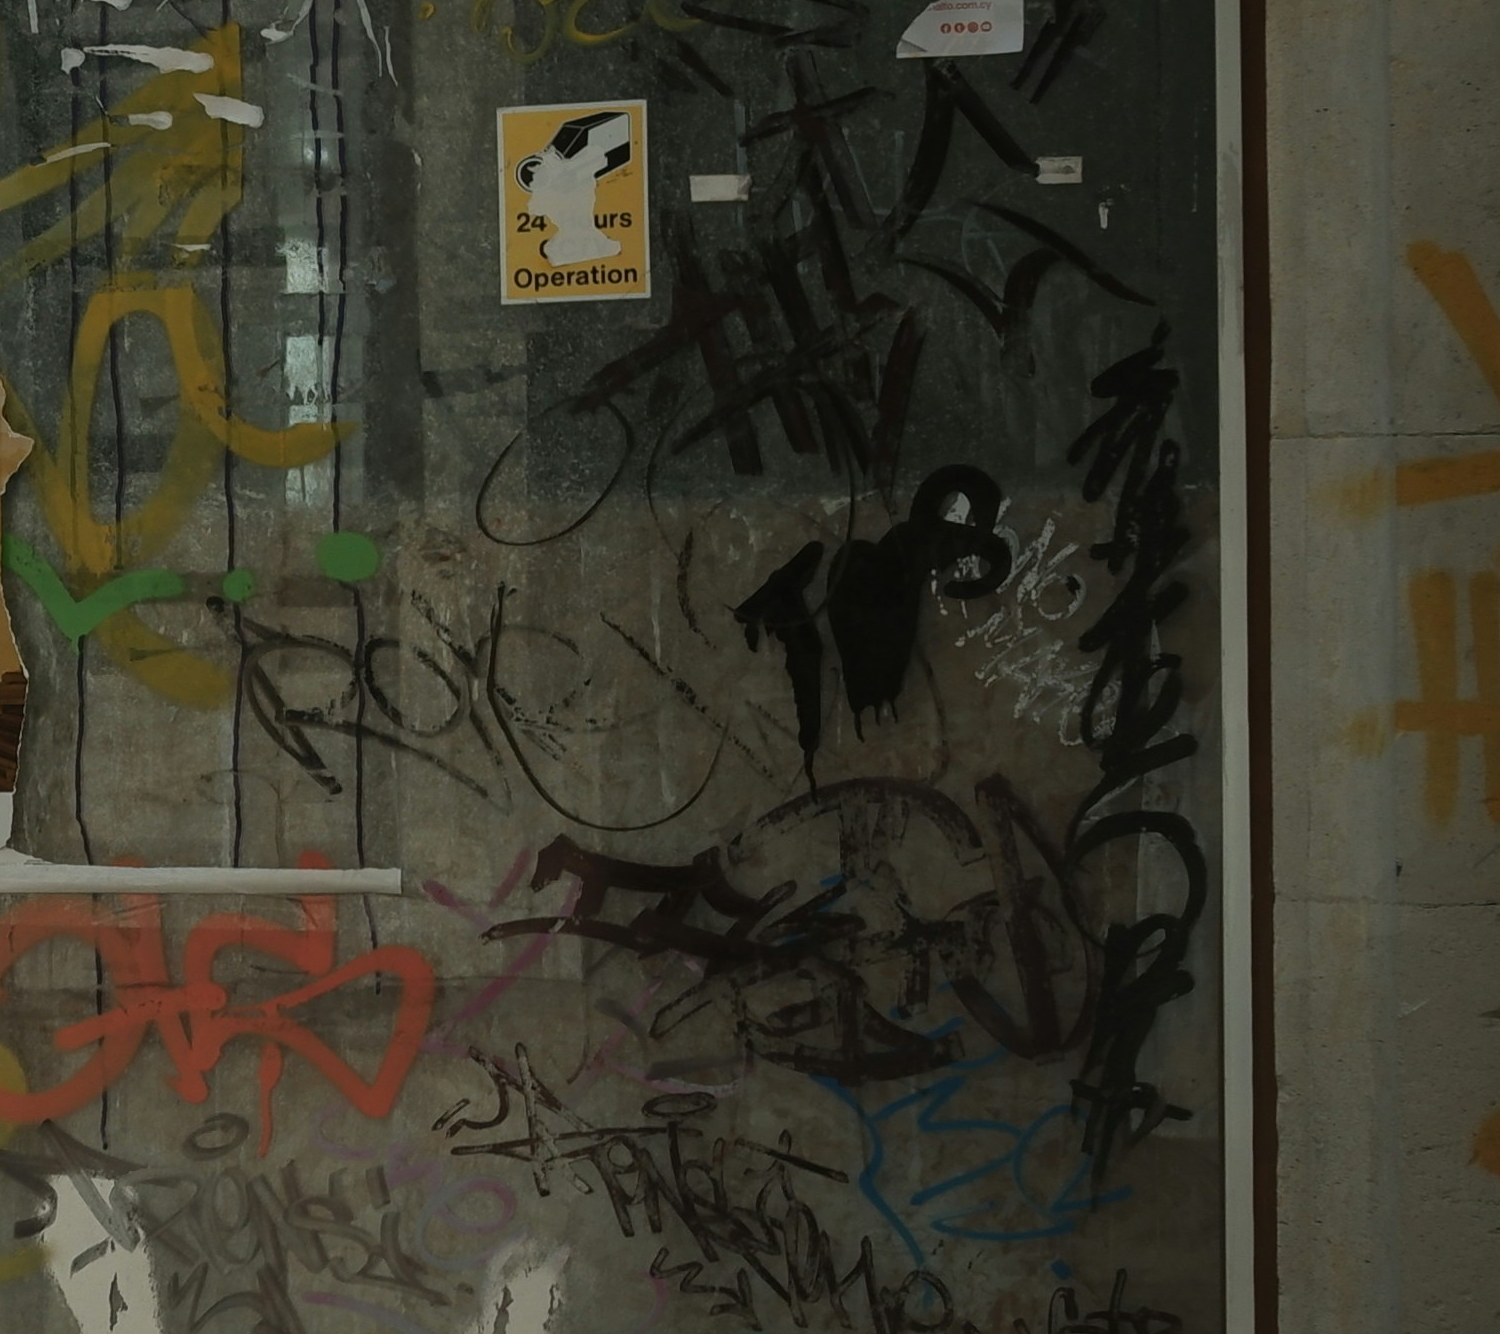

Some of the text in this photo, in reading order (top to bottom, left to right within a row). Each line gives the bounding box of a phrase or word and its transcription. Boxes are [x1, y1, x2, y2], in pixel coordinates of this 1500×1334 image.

[516, 212, 633, 233] 24 urs
[514, 265, 638, 291] Operation
